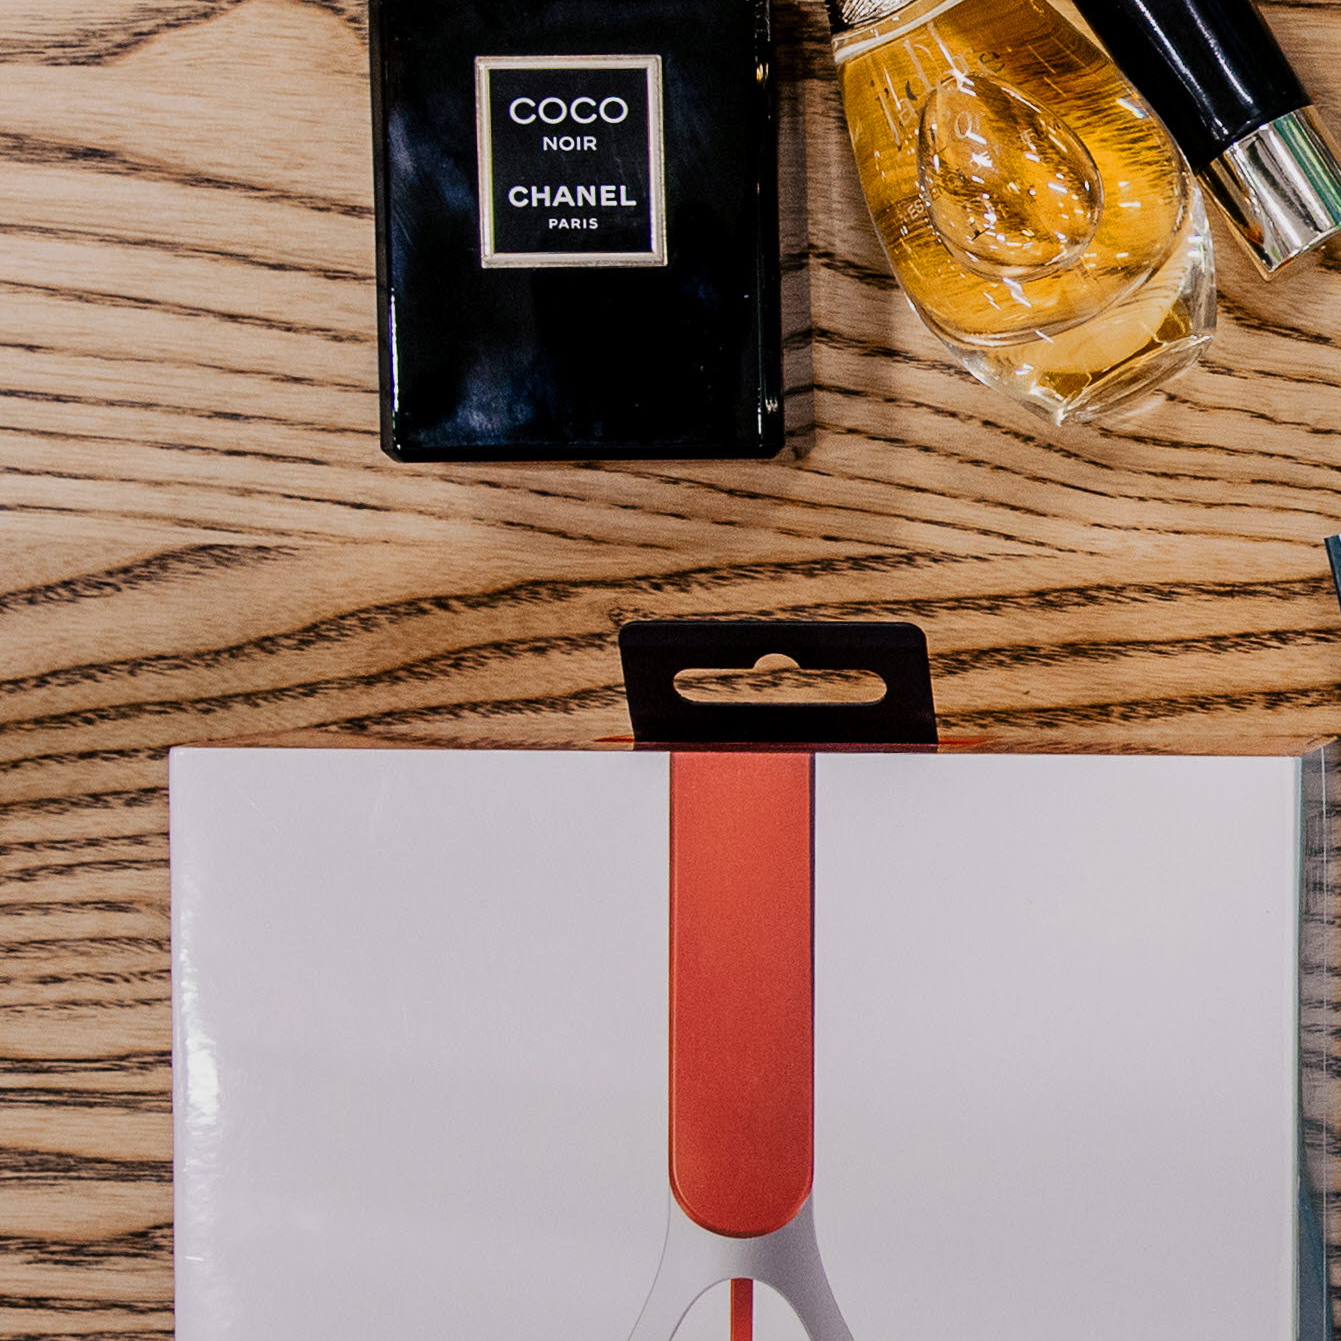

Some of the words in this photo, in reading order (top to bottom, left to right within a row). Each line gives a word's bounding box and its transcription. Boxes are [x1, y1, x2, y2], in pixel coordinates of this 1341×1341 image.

[509, 96, 628, 124] COCO
[542, 135, 597, 152] NOIR
[508, 185, 636, 207] CHANEL
[548, 217, 598, 230] PARIS
